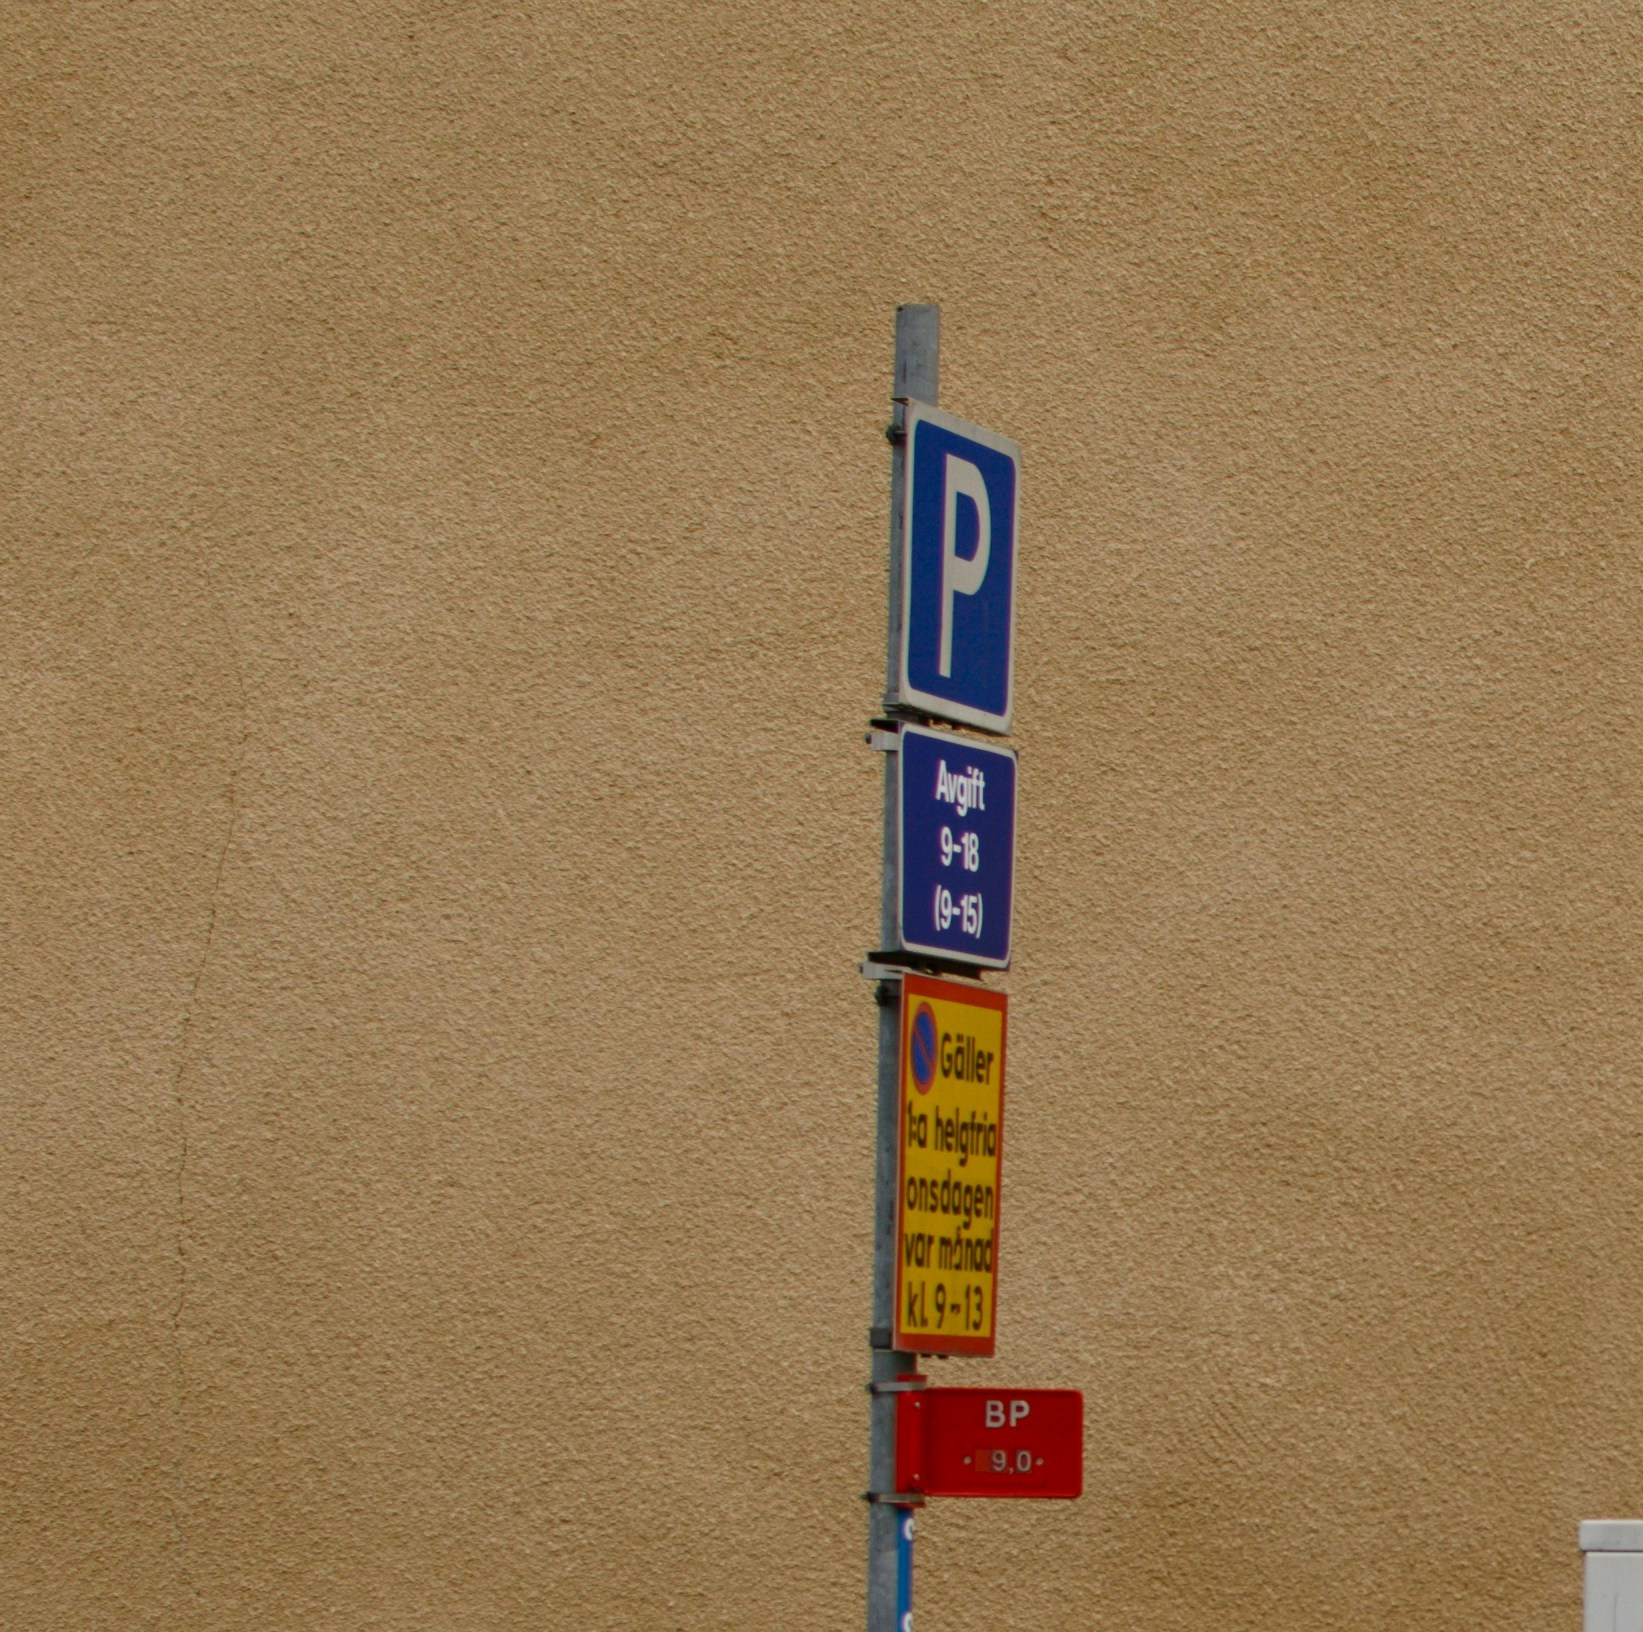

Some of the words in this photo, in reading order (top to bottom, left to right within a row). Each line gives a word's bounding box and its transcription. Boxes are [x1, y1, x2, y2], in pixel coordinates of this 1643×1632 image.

[938, 453, 991, 678] P
[936, 760, 985, 816] Avgift
[941, 827, 980, 872] 9-18
[935, 885, 982, 938] (9-15)
[941, 1032, 994, 1085] Gäller
[908, 1100, 927, 1148] 1:a
[935, 1105, 997, 1167] helgfria
[906, 1169, 993, 1230] onsdagen
[905, 1232, 934, 1269] var
[938, 1226, 994, 1273] månad
[907, 1281, 928, 1328] kl.
[985, 1400, 1030, 1428] BP
